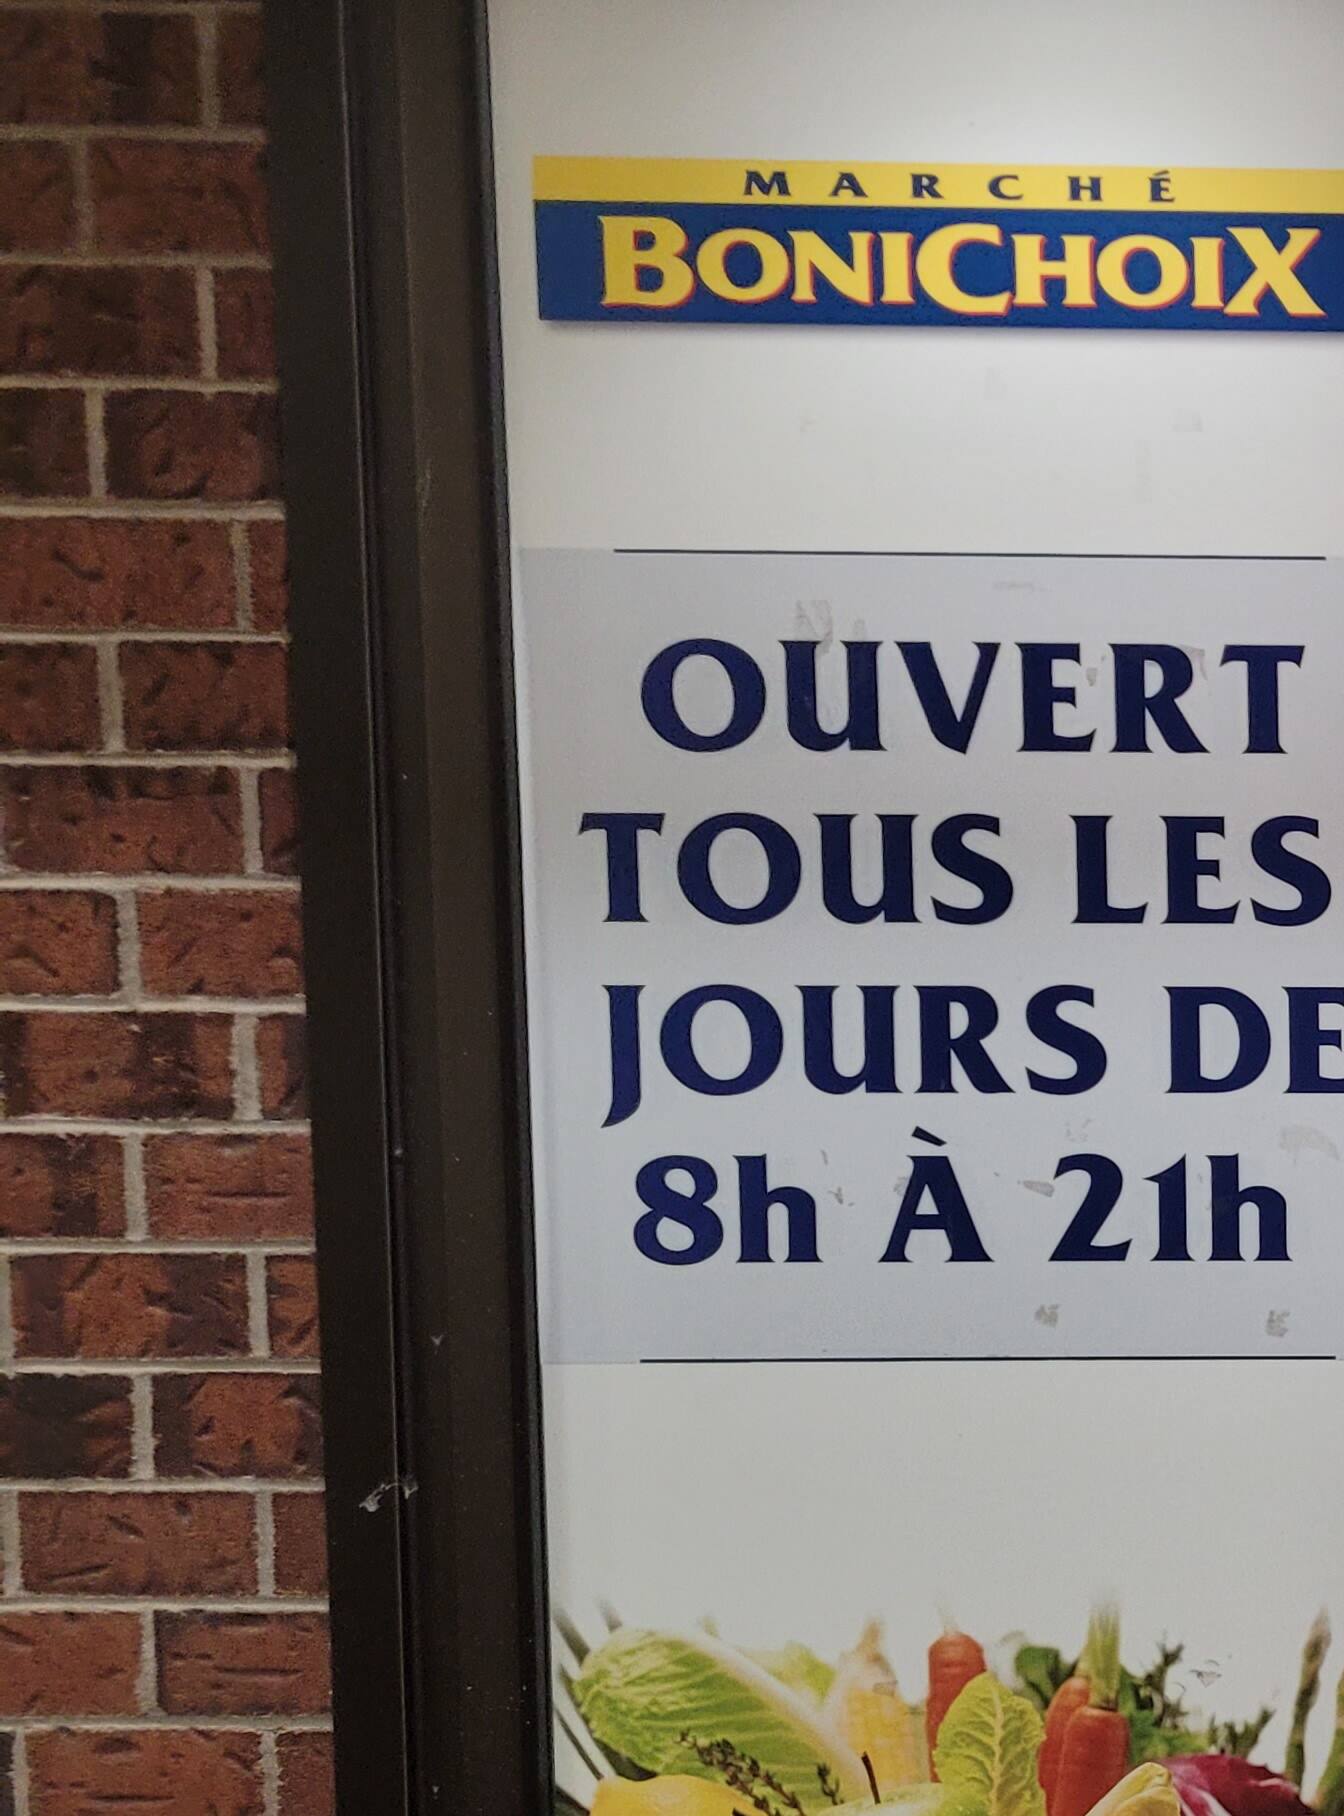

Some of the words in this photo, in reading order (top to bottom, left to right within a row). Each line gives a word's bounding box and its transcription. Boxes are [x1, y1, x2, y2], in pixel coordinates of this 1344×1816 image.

[742, 169, 1178, 205] MARCHÉ
[599, 215, 1329, 319] BONICHOIX
[639, 637, 1306, 756] OUVERT
[576, 810, 1016, 927] TOUS
[1068, 813, 1334, 929] LES
[599, 983, 1109, 1129] JOURS
[632, 1152, 821, 1267] 8h
[878, 1125, 996, 1264] À
[1047, 1151, 1294, 1264] 21h
